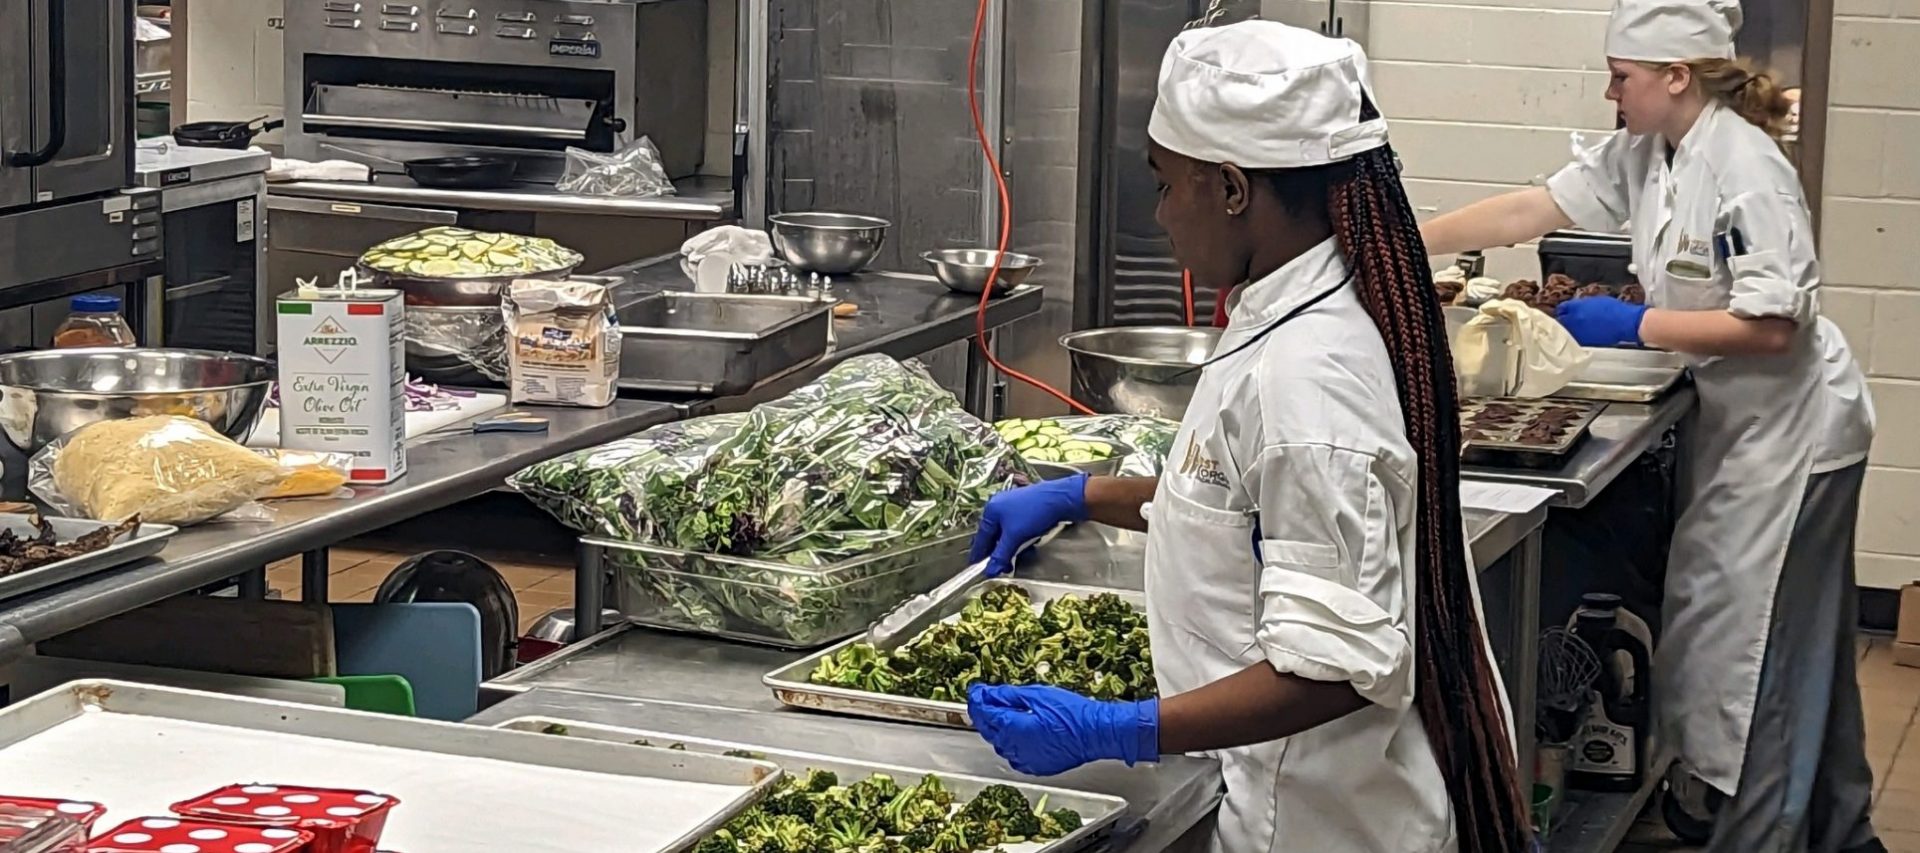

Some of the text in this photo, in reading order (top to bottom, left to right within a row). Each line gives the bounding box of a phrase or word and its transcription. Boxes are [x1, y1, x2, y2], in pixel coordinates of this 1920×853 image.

[303, 337, 357, 346] ARREZZIO
[293, 376, 369, 399] Extra Virgin
[304, 396, 361, 412] Olive Oil
